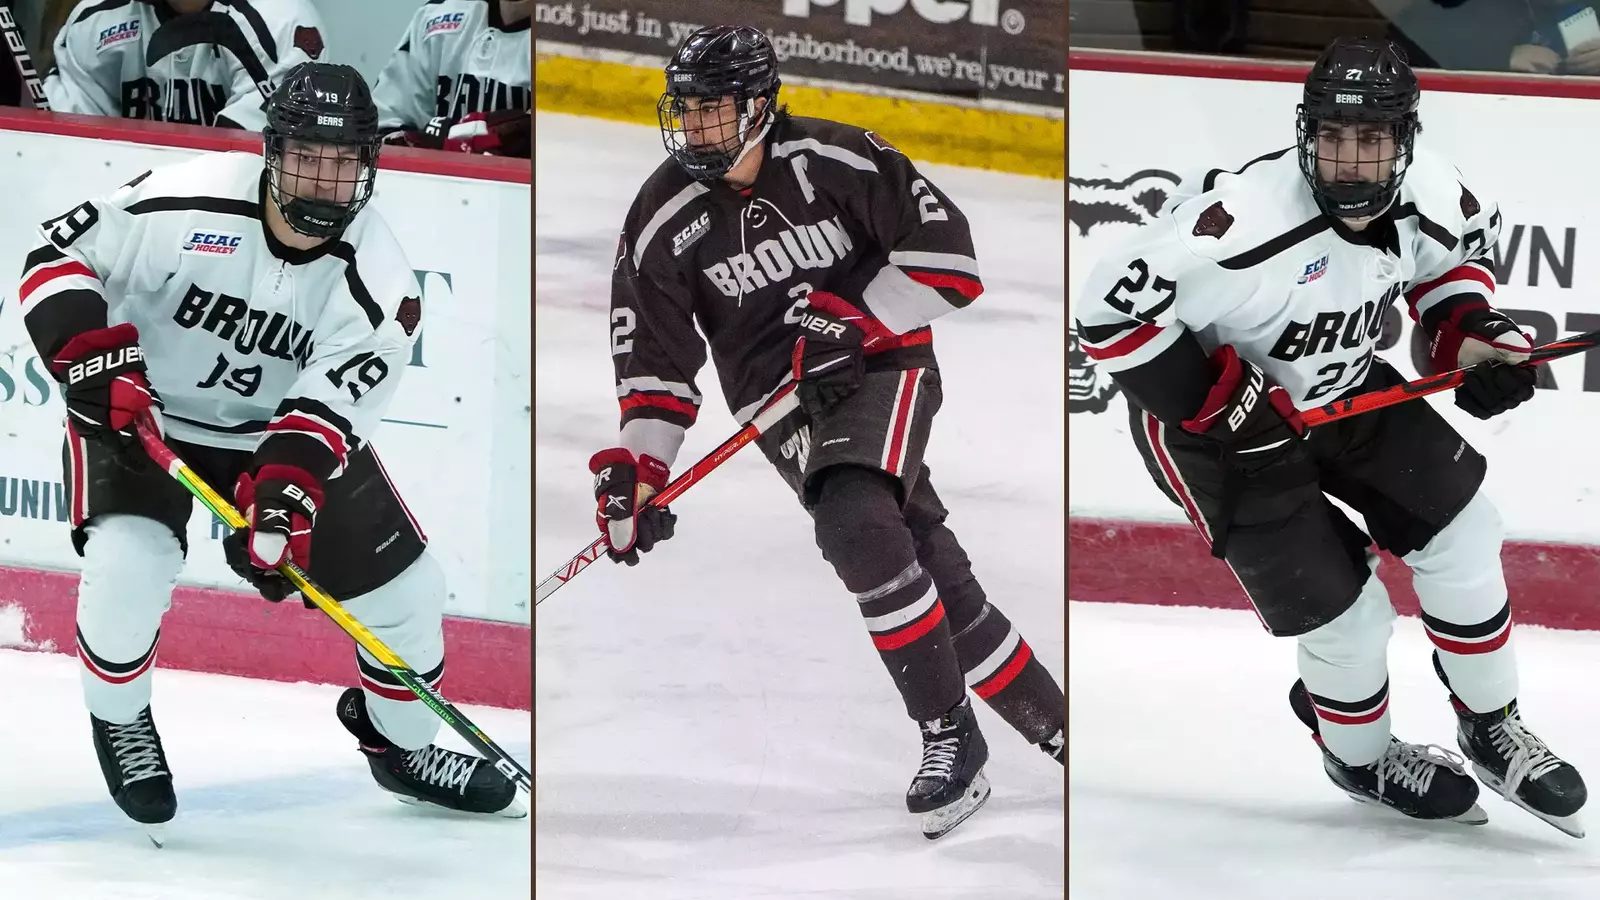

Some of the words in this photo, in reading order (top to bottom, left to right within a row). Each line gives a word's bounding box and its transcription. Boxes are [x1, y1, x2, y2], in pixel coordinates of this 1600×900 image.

[100, 20, 139, 41] ECAC
[536, 2, 576, 28] not
[578, 8, 631, 36] just
[636, 12, 662, 38] in
[987, 63, 1048, 90] your
[1345, 69, 1362, 80] 27
[325, 93, 338, 103] 19
[1336, 93, 1363, 104] BEARS
[317, 115, 344, 127] BEARS
[911, 178, 949, 223] 2
[190, 233, 242, 247] ECAC
[672, 211, 710, 248] ECAC
[194, 244, 236, 254] HOCKEY
[703, 214, 853, 298] BROWN
[1104, 258, 1177, 325] 27
[610, 307, 636, 356] 2
[196, 352, 262, 397] 19
[414, 676, 451, 706] BAUER
